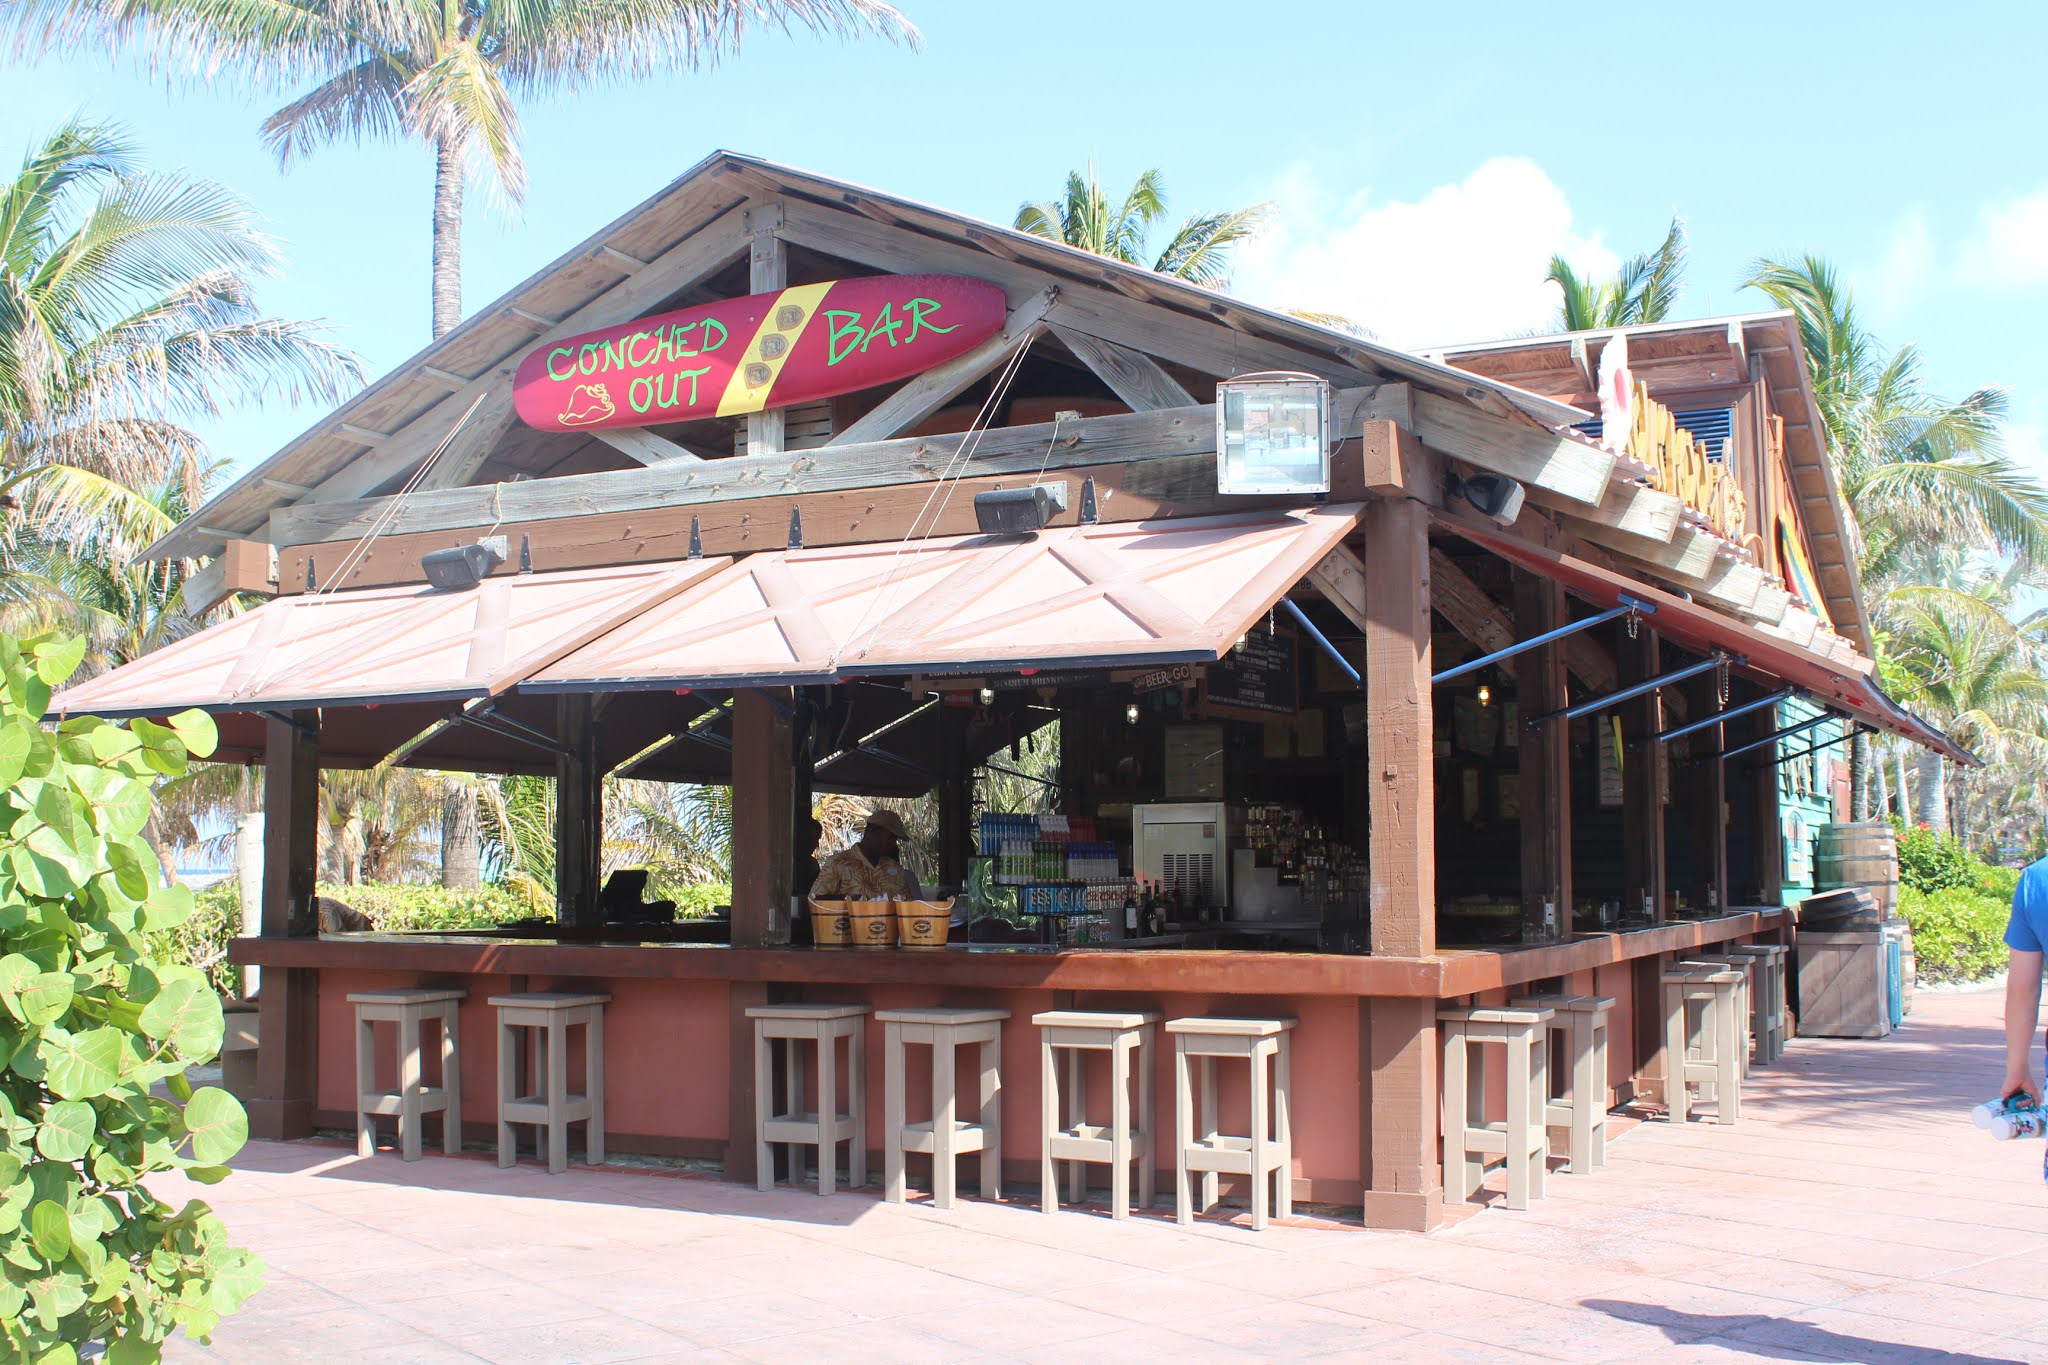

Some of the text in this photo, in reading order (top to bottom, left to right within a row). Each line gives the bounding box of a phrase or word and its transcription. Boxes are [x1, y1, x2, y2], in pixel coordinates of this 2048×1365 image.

[546, 318, 728, 382] CONCHED
[821, 297, 964, 366] BAR
[628, 366, 712, 414] OUT
[1146, 671, 1172, 687] BEER
[1173, 665, 1189, 680] GO
